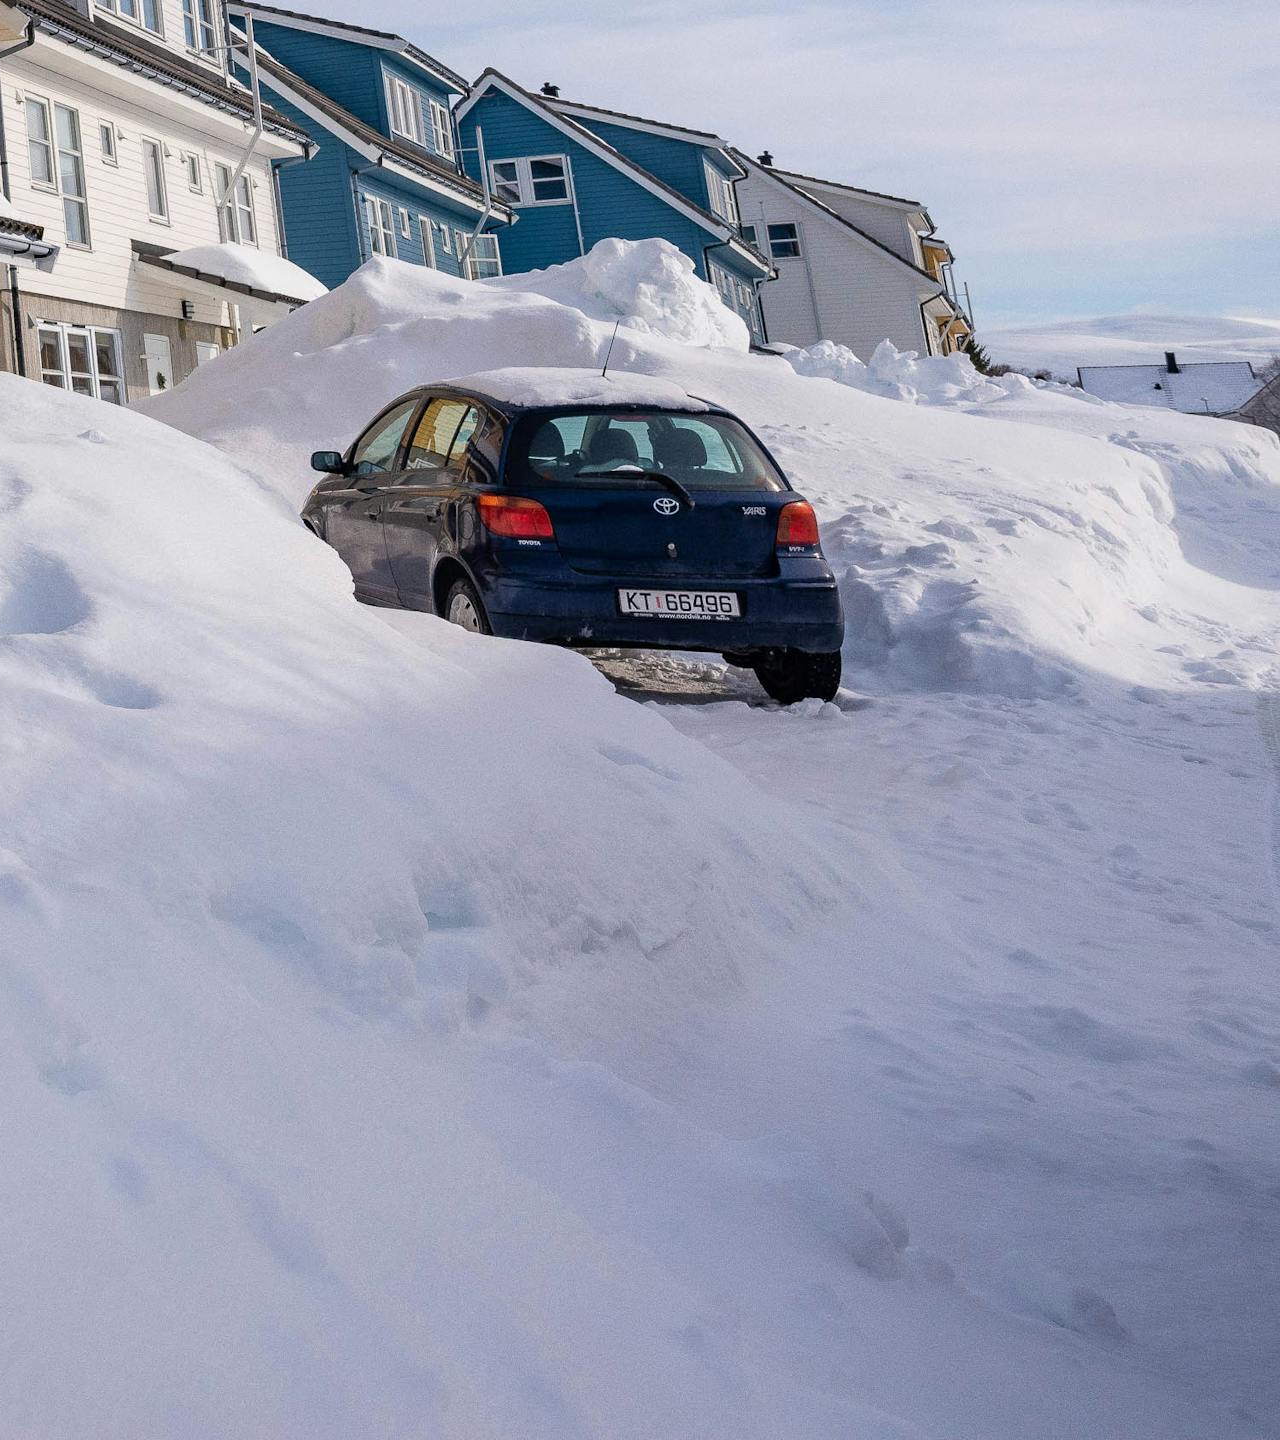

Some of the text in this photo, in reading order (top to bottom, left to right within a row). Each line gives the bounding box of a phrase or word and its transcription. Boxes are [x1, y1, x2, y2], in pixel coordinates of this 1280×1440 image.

[742, 506, 767, 516] YARIS
[626, 592, 732, 613] KT 66496
[658, 612, 711, 621] www.nordvik.no
